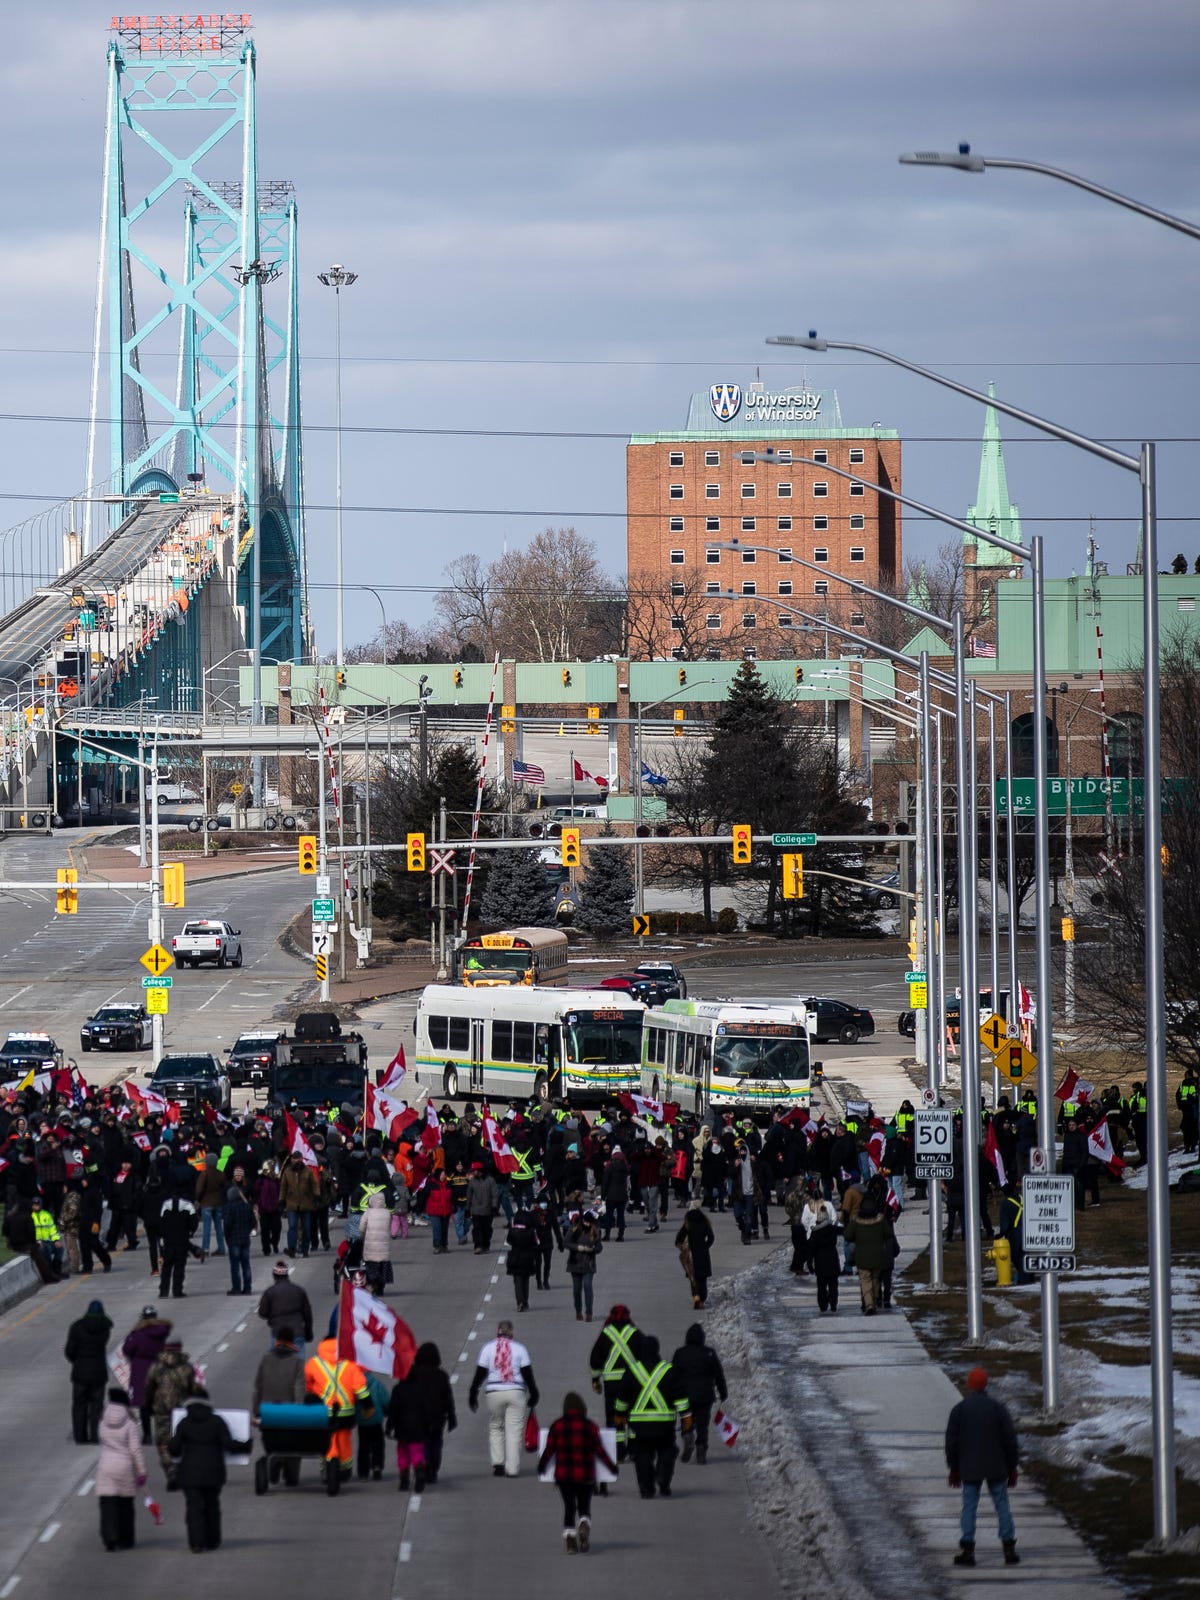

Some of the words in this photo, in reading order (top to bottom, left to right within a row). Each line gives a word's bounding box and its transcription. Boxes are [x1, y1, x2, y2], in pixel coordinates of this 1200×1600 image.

[109, 14, 251, 29] AMBASSADOR
[141, 36, 221, 51] BRIDGE
[745, 391, 821, 408] University
[745, 412, 756, 421] of
[757, 407, 821, 421] Windsor
[999, 796, 1031, 805] CRS
[775, 835, 807, 845] College
[143, 978, 166, 987] College
[906, 974, 927, 982] Colleg
[592, 1010, 624, 1020] SPECIAL
[917, 1113, 949, 1123] MAXIMUM
[919, 1126, 948, 1145] 50
[920, 1154, 947, 1162] km/h
[918, 1168, 951, 1177] BEGINS
[1026, 1180, 1071, 1191] COMMUNITY
[1034, 1194, 1062, 1204] SAFETY
[1038, 1207, 1058, 1217] ZONE
[1038, 1223, 1060, 1233] FINES
[1026, 1236, 1072, 1246] INCREASED
[1028, 1257, 1071, 1270] ENDS
